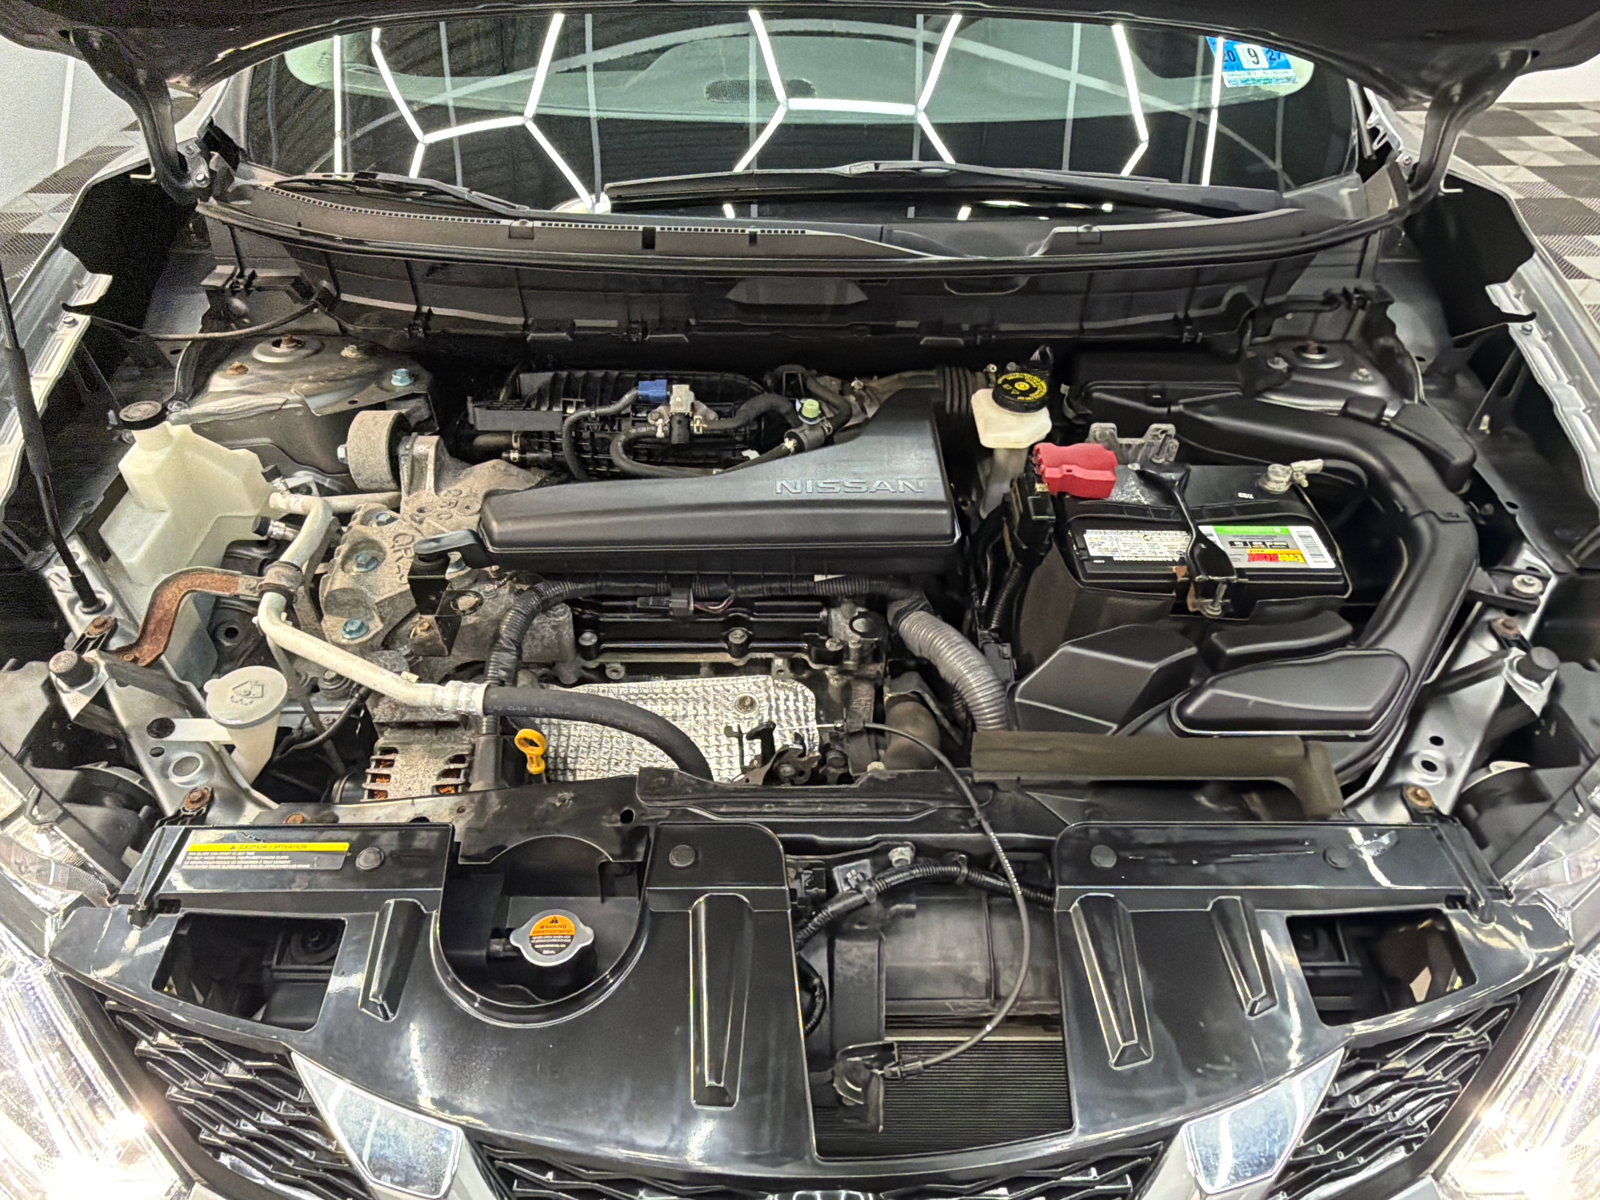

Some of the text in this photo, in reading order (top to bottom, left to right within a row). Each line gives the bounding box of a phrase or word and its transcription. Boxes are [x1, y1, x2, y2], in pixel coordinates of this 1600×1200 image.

[1246, 47, 1260, 65] 9
[775, 478, 925, 495] NISSAN
[1248, 553, 1305, 563] EverStart
